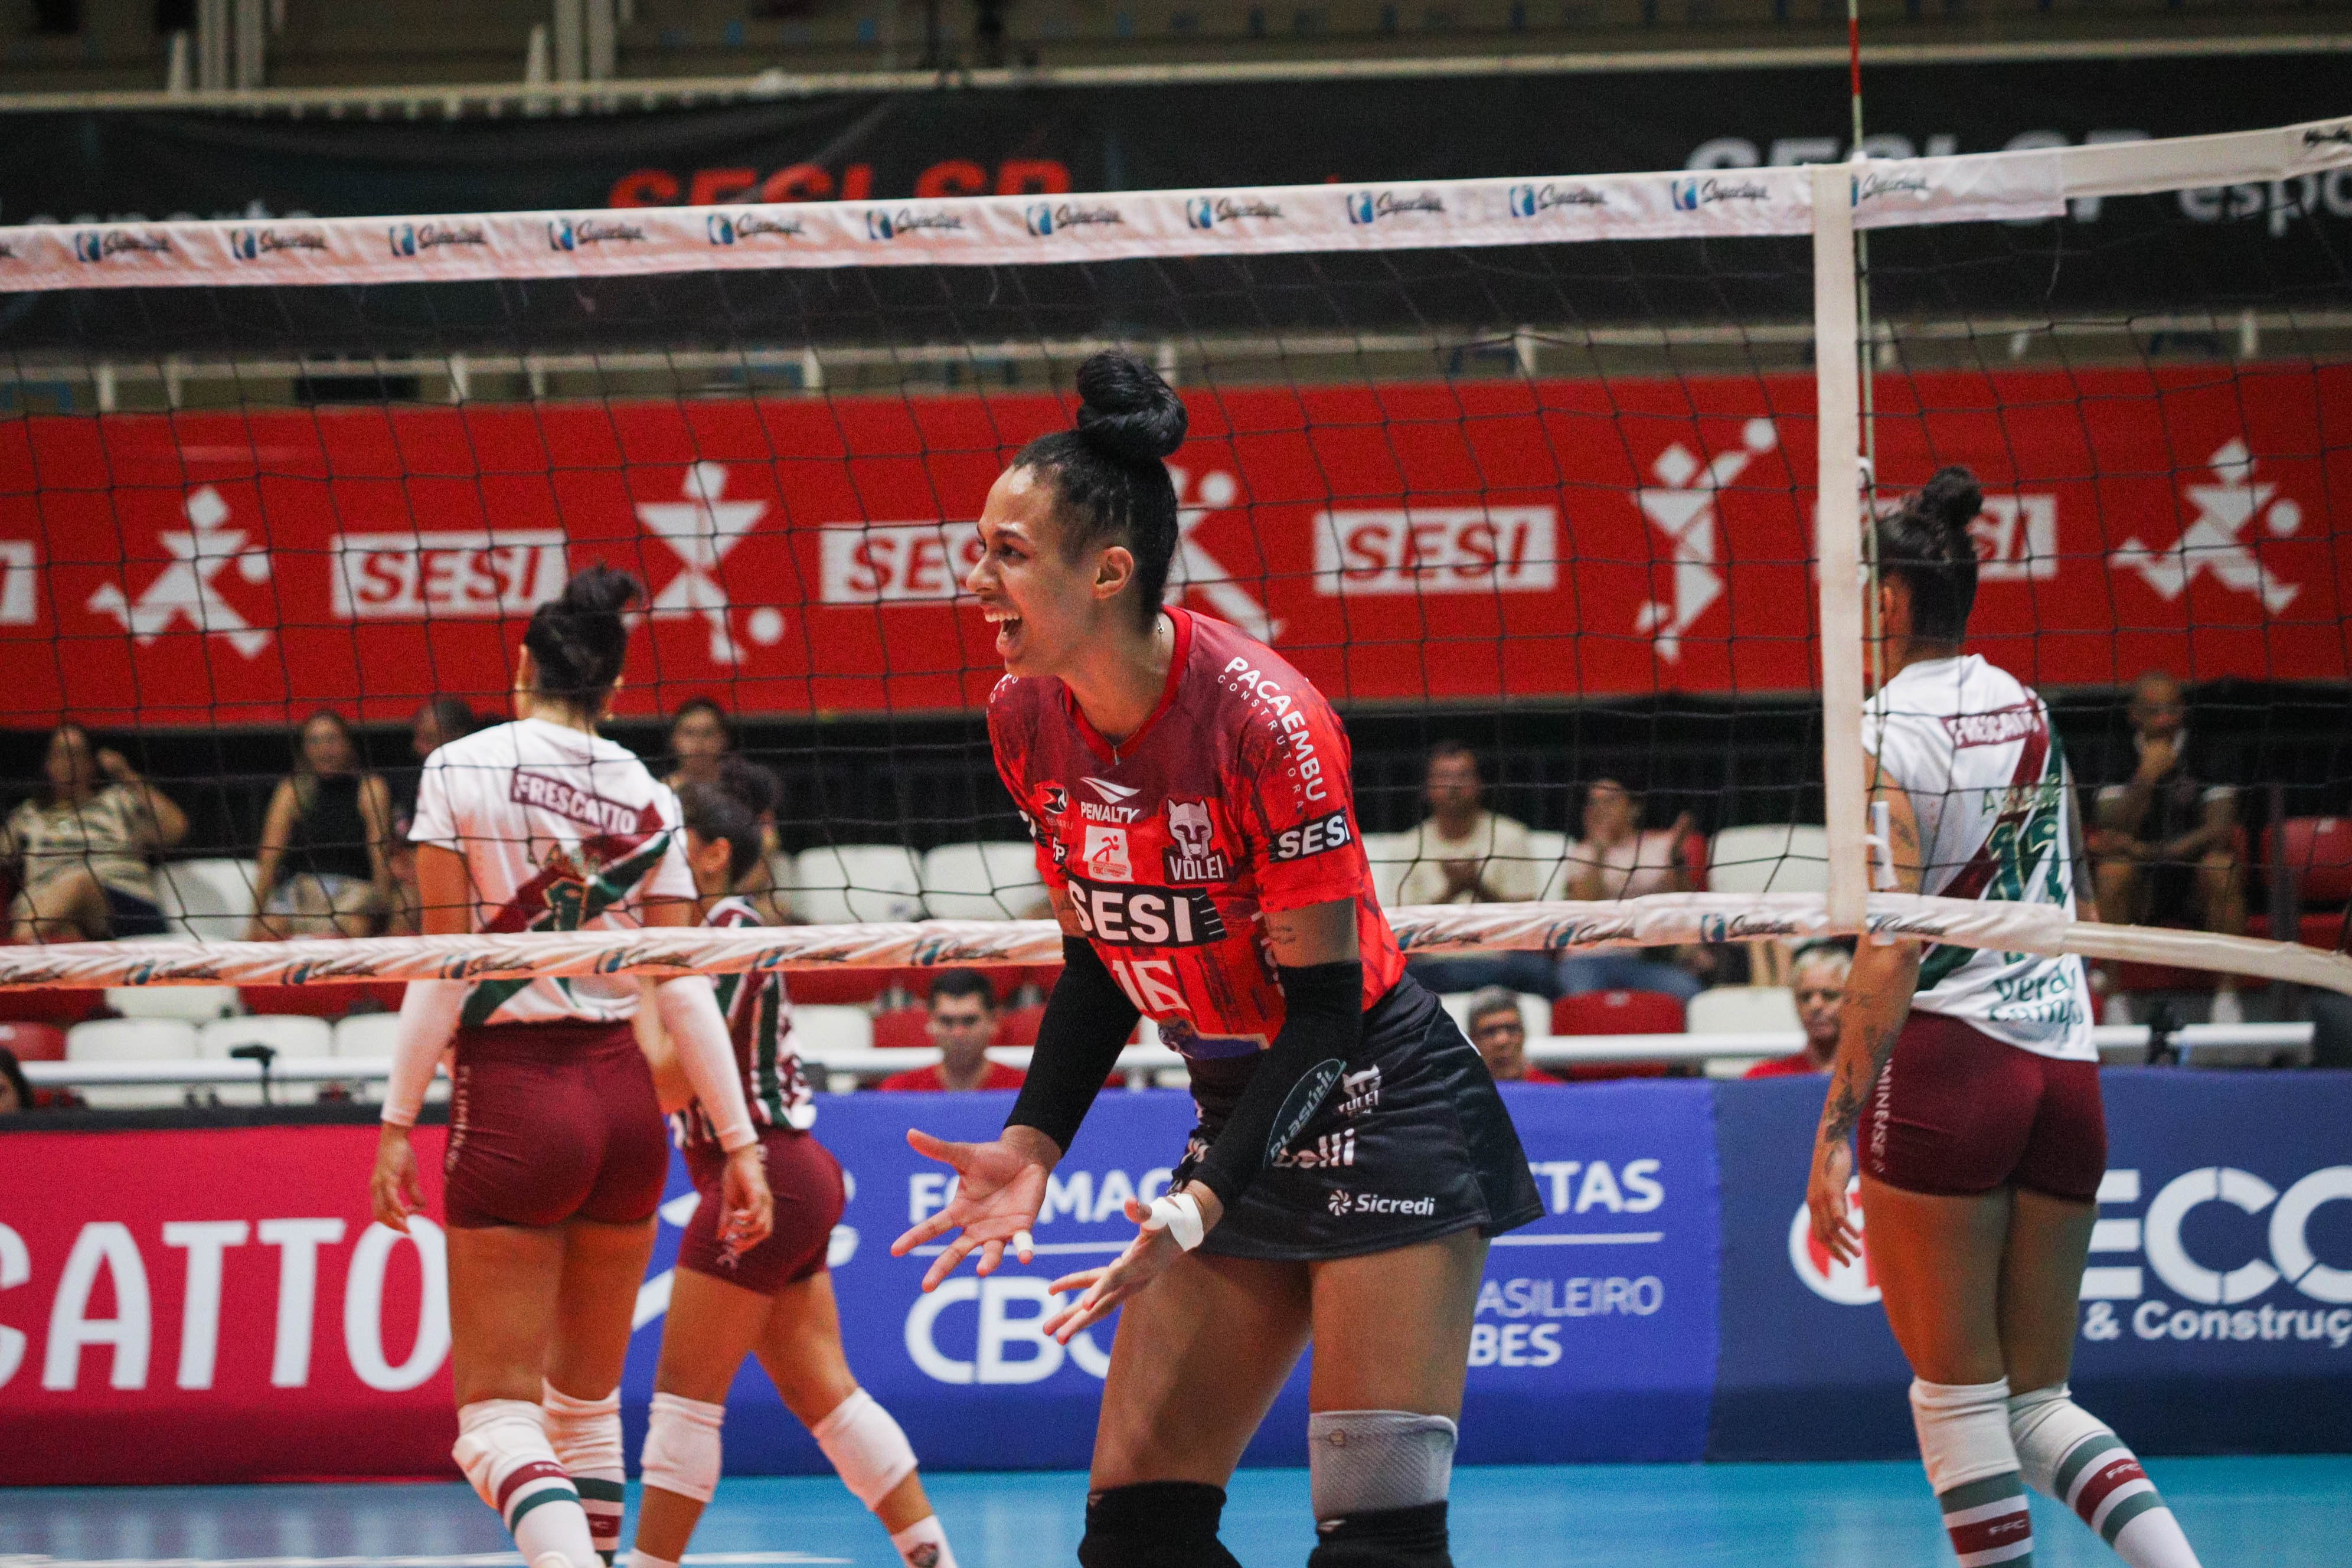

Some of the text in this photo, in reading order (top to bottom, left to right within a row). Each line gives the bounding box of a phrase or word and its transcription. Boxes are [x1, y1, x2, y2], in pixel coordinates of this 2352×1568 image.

[360, 546, 542, 603] SESI
[847, 533, 985, 593] SE
[1342, 520, 1529, 582] SESI
[1217, 674, 1304, 809] CONSTRUTORA
[1224, 656, 1327, 802] PACAEMBU
[1080, 801, 1140, 824] PENALTY
[1278, 814, 1351, 859] SESI
[1068, 879, 1194, 943] SESI
[1355, 1194, 1436, 1216] Sicredi
[1528, 1159, 1665, 1214] TAS
[1475, 1276, 1664, 1318] ASILEIRO
[2082, 1301, 2121, 1341] &
[1467, 1324, 1563, 1367] BES
